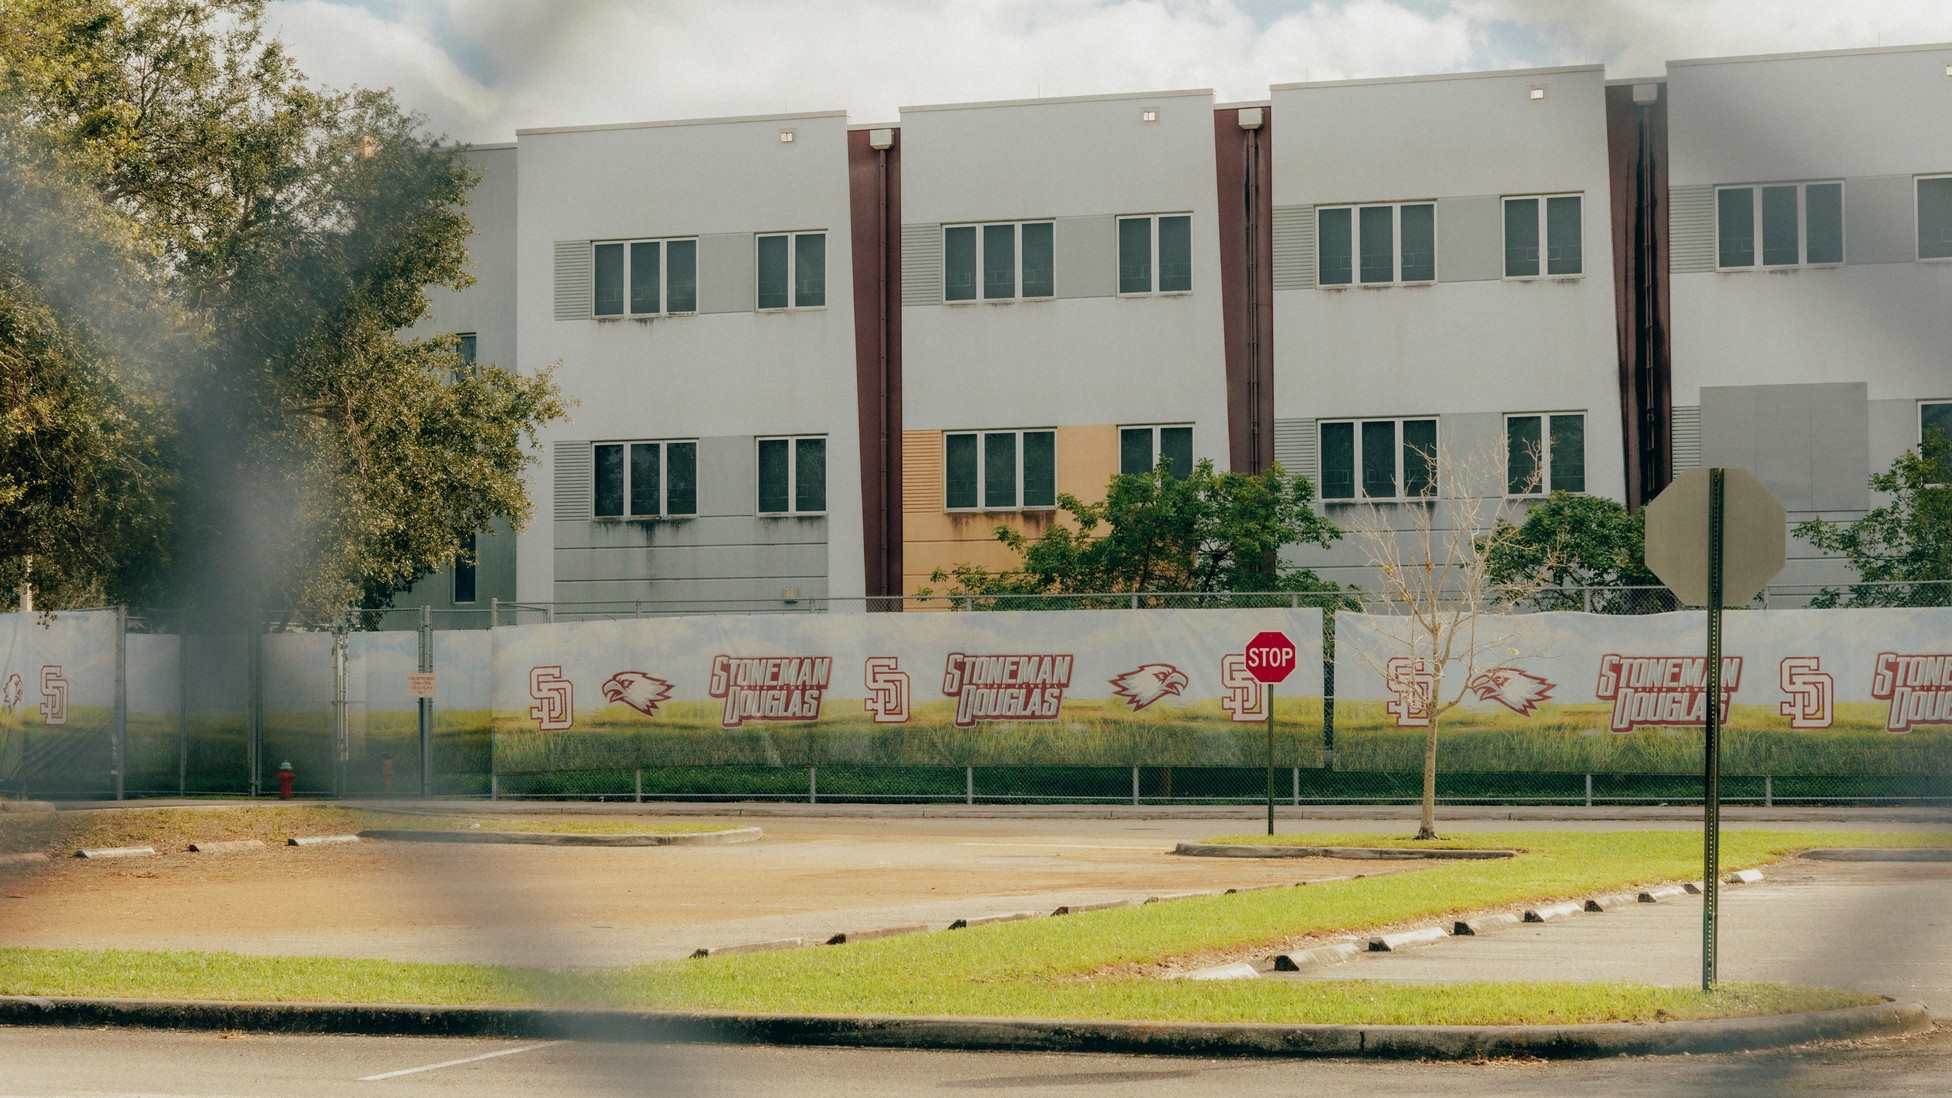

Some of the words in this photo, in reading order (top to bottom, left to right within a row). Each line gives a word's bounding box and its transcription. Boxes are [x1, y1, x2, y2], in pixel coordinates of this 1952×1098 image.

[709, 655, 831, 696] STONEMAN
[943, 653, 1072, 695] STONEMAN
[1248, 647, 1293, 667] STOP
[723, 686, 821, 725] DOUGLAS
[956, 684, 1062, 725] DOUGLAS
